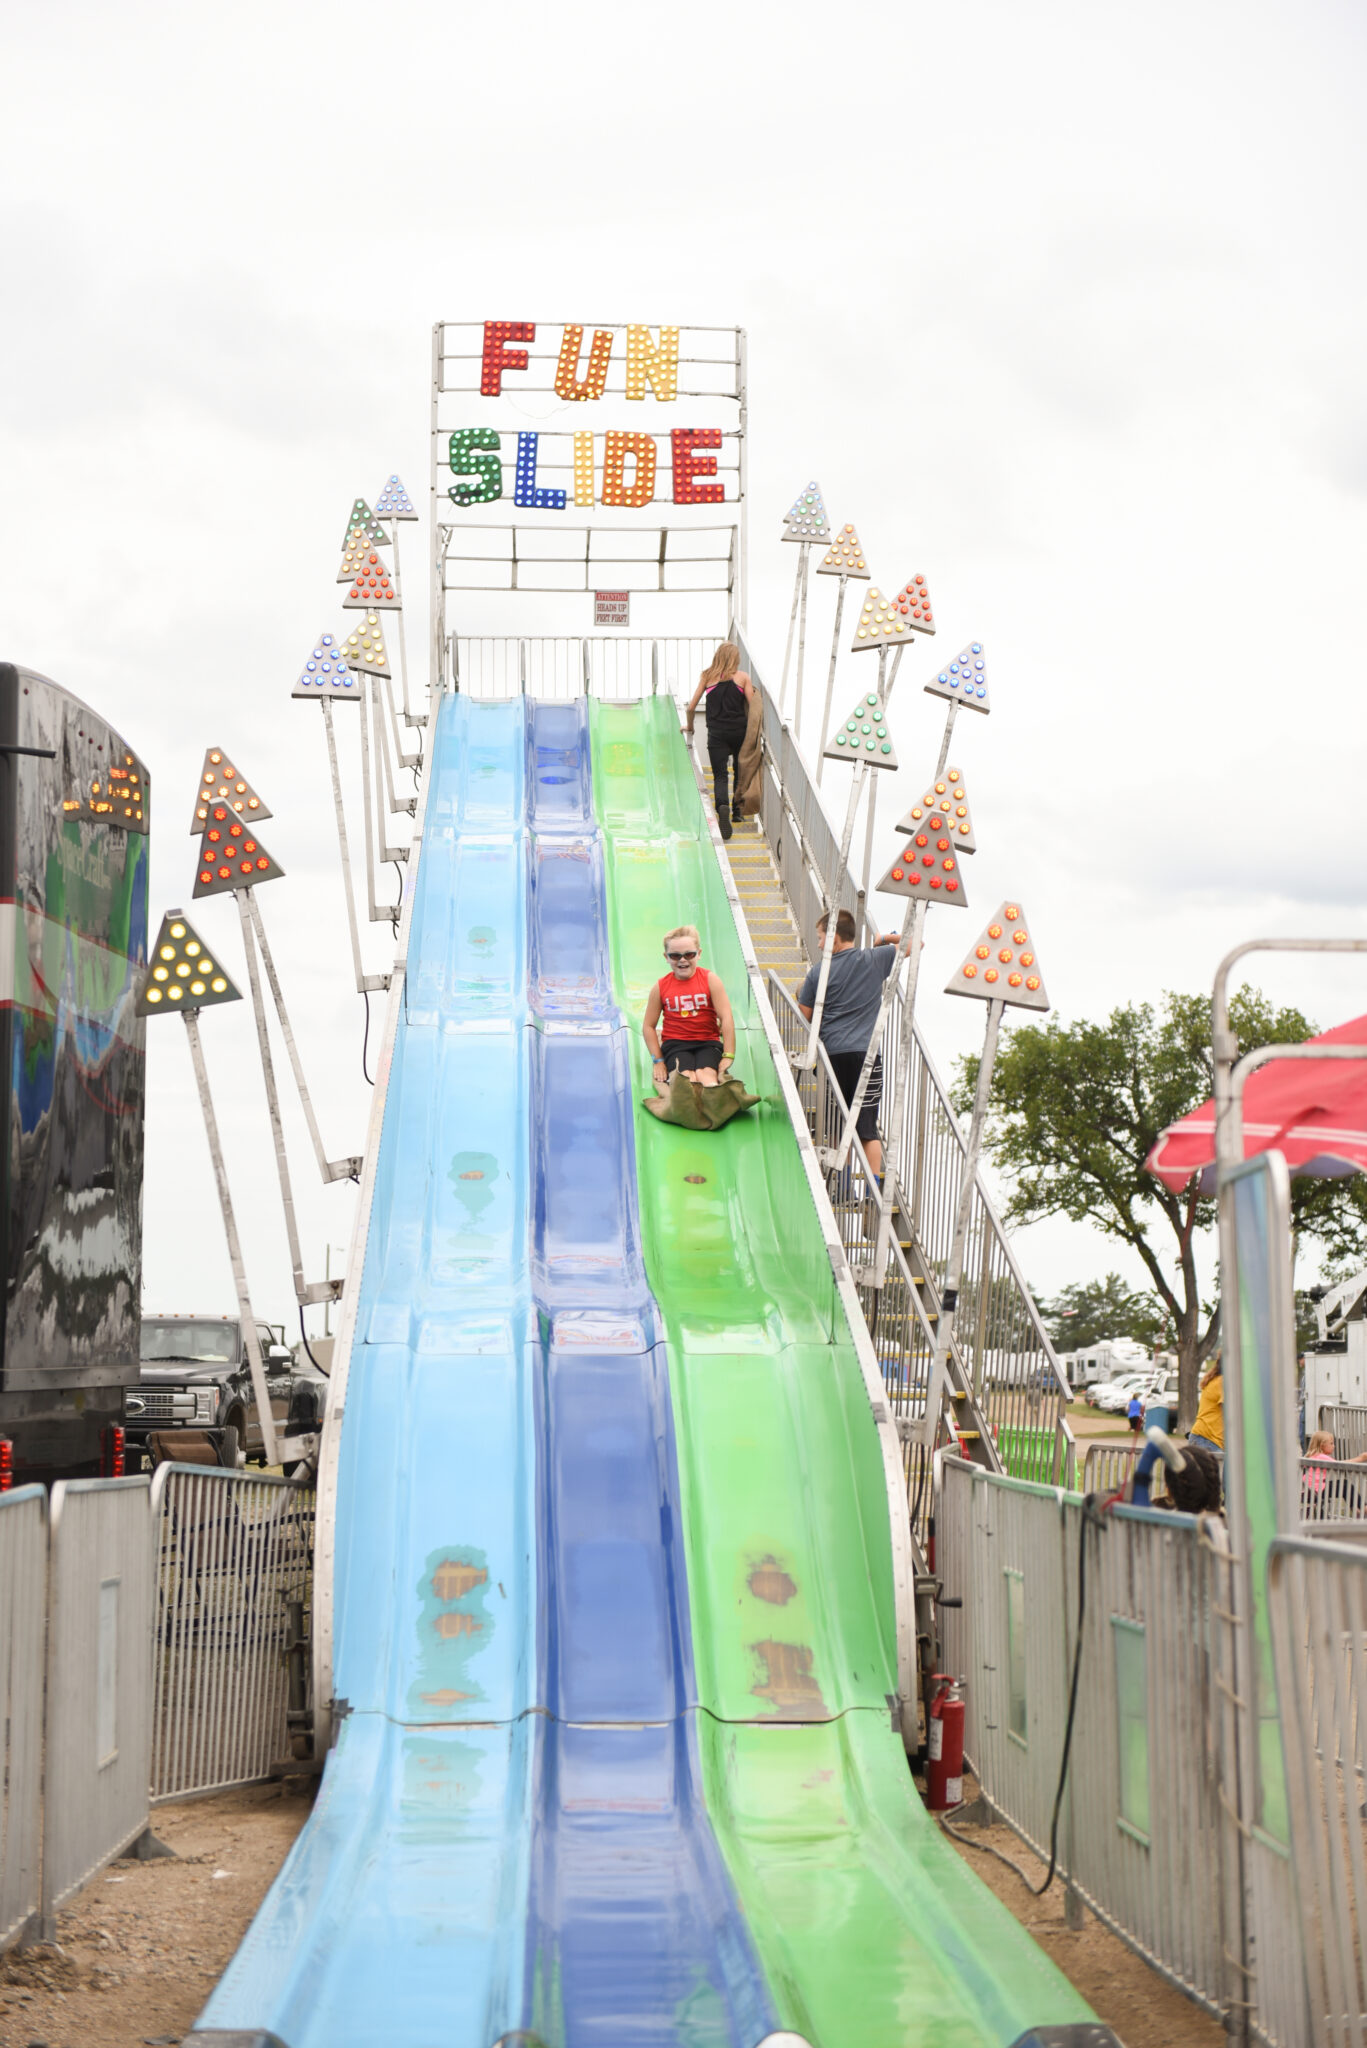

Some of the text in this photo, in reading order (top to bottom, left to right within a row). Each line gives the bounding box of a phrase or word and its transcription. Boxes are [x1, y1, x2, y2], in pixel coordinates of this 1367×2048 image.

[480, 320, 680, 402] FUN
[448, 427, 725, 510] SLIDE
[597, 603, 626, 612] HEADS UP
[597, 614, 627, 622] FEET FIRST
[665, 993, 708, 1012] USA
